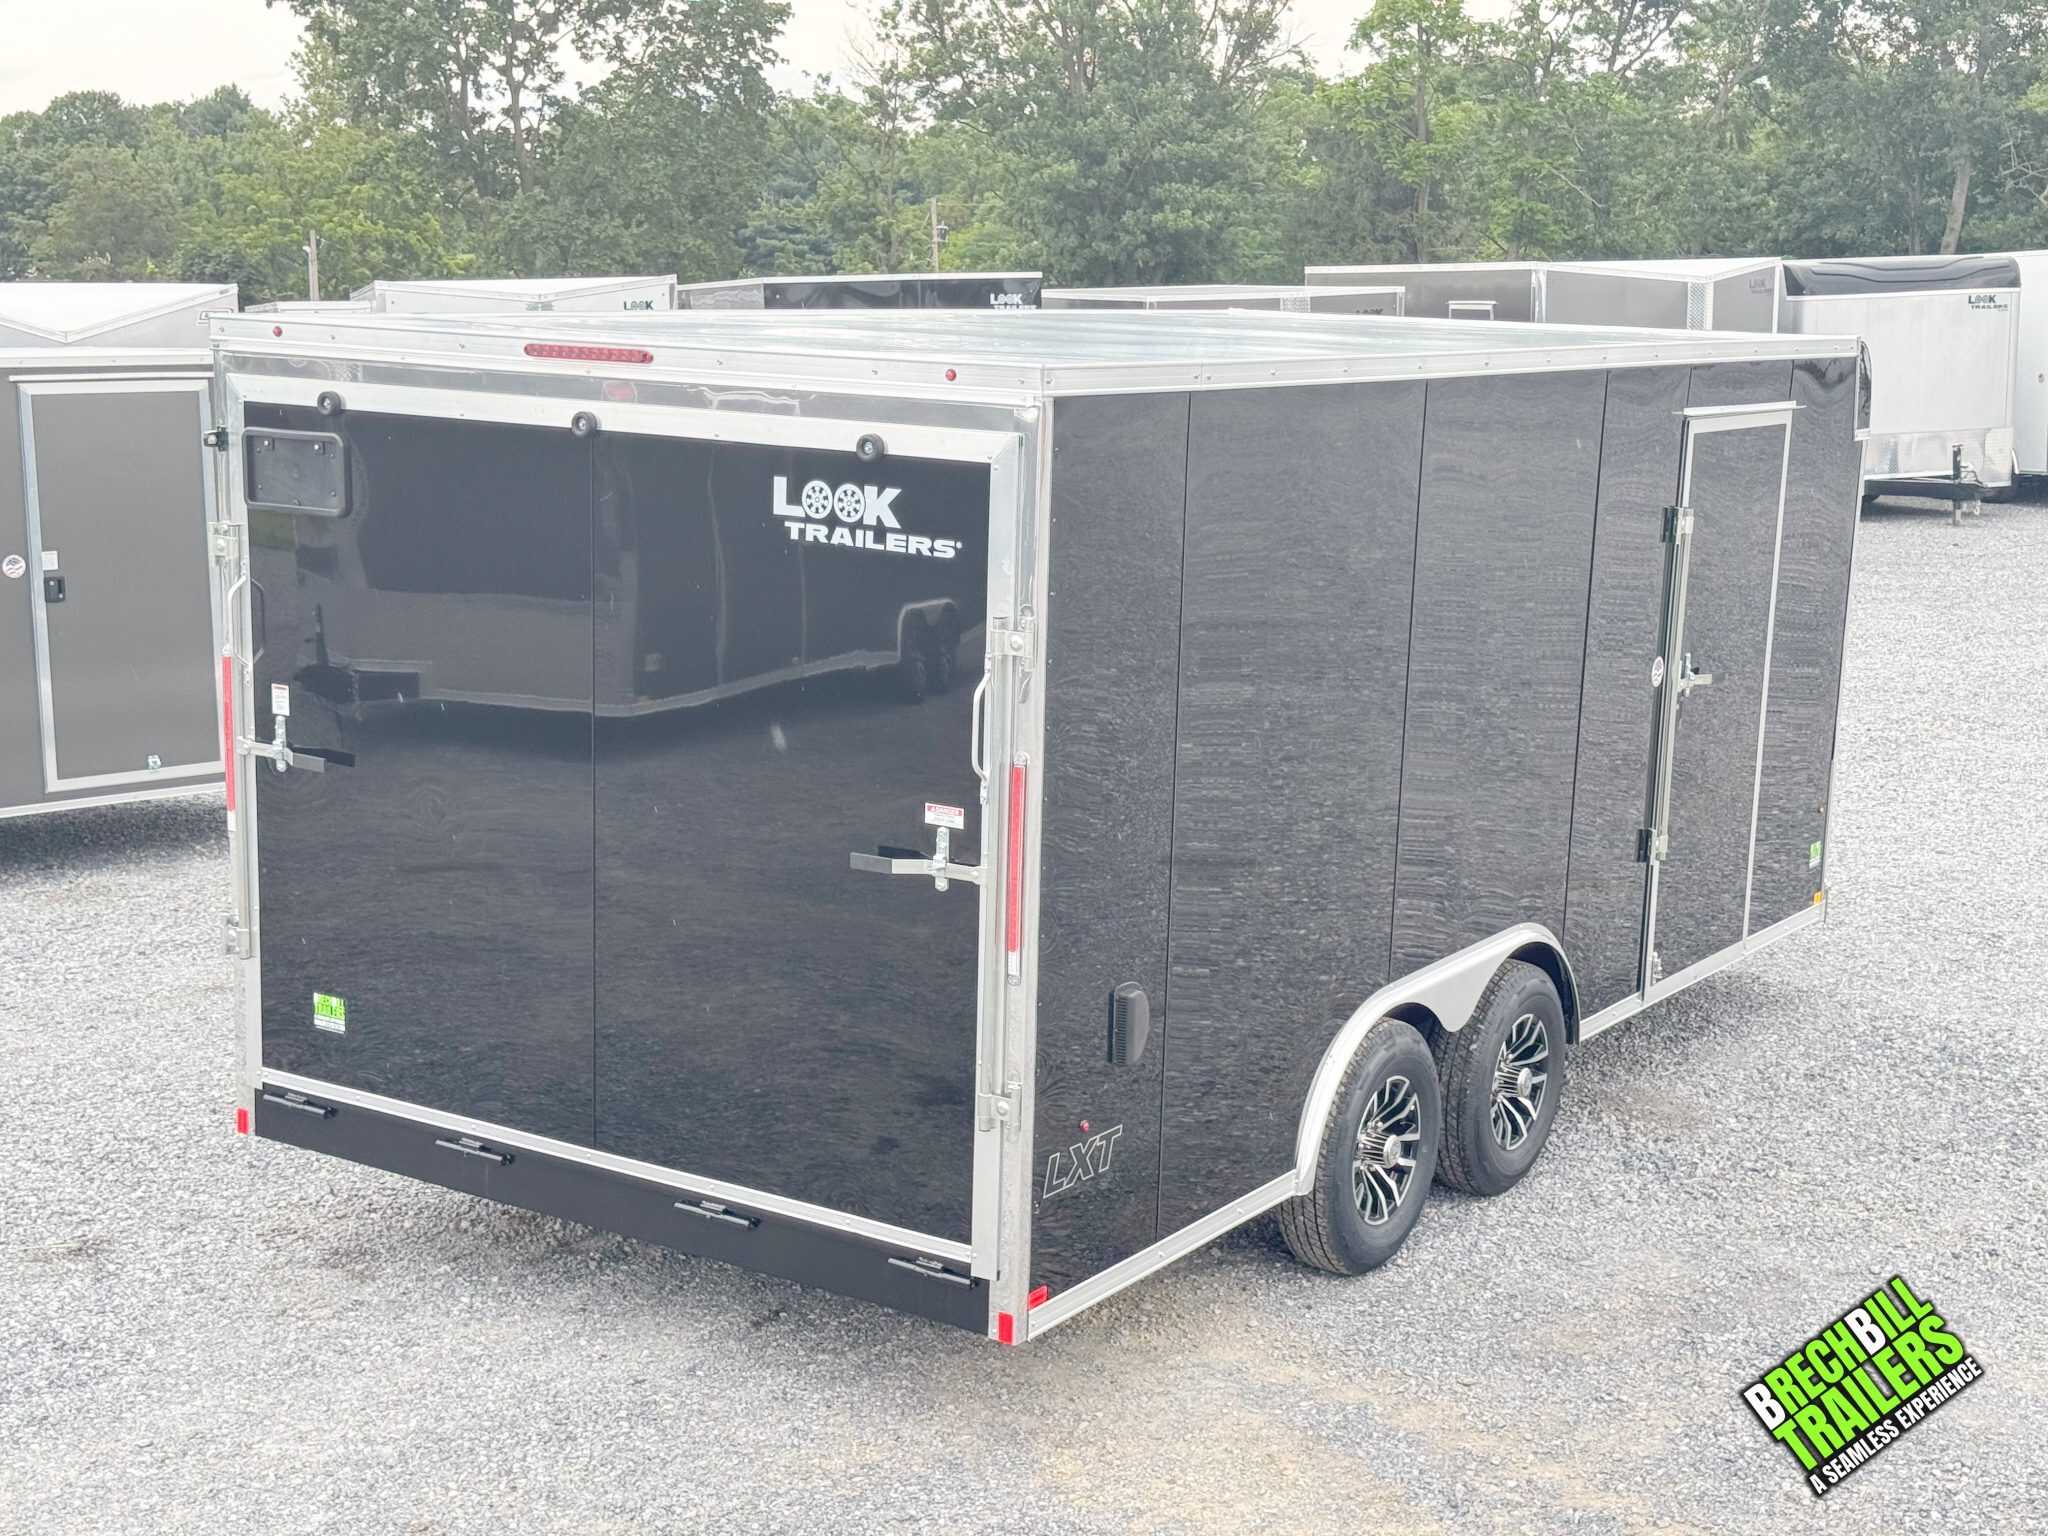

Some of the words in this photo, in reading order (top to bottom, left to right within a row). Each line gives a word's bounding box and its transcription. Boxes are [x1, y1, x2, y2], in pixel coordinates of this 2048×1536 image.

[623, 300, 654, 311] LOOK
[990, 293, 1023, 305] LOOK
[1968, 294, 1997, 304] LOOK
[773, 475, 902, 529] LOOK
[784, 521, 956, 558] TRAILERS
[1043, 1124, 1123, 1199] LXT
